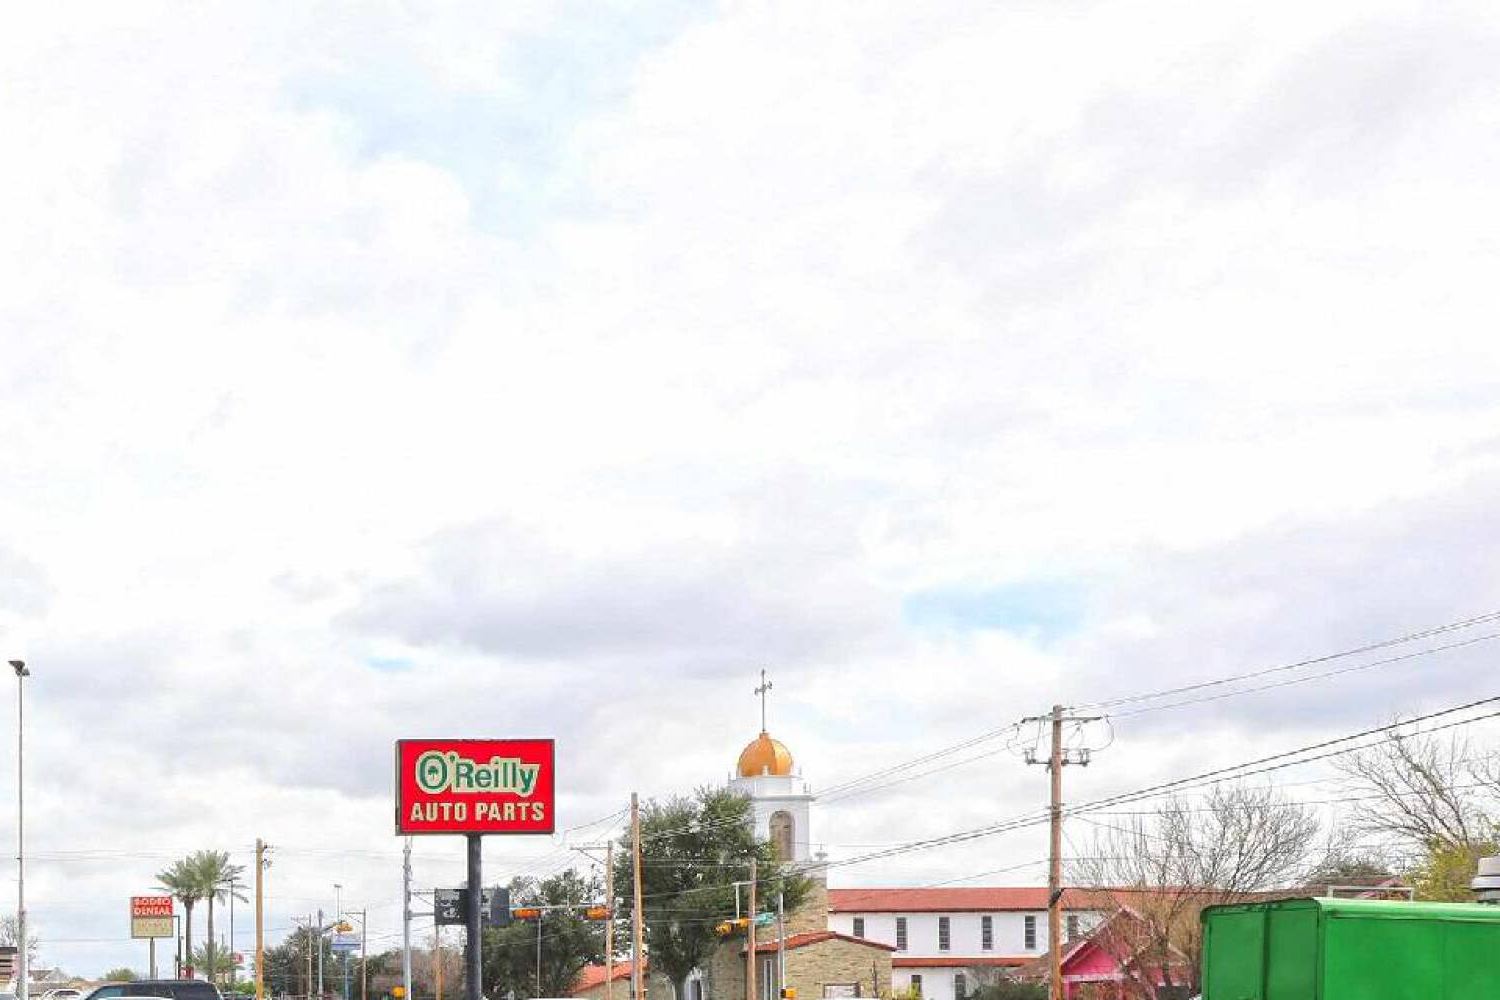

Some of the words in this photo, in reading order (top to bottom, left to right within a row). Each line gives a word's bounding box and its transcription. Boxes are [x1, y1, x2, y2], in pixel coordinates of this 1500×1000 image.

[417, 752, 537, 795] O'Reilly
[410, 802, 467, 822] AUTO
[475, 802, 545, 822] PARTS
